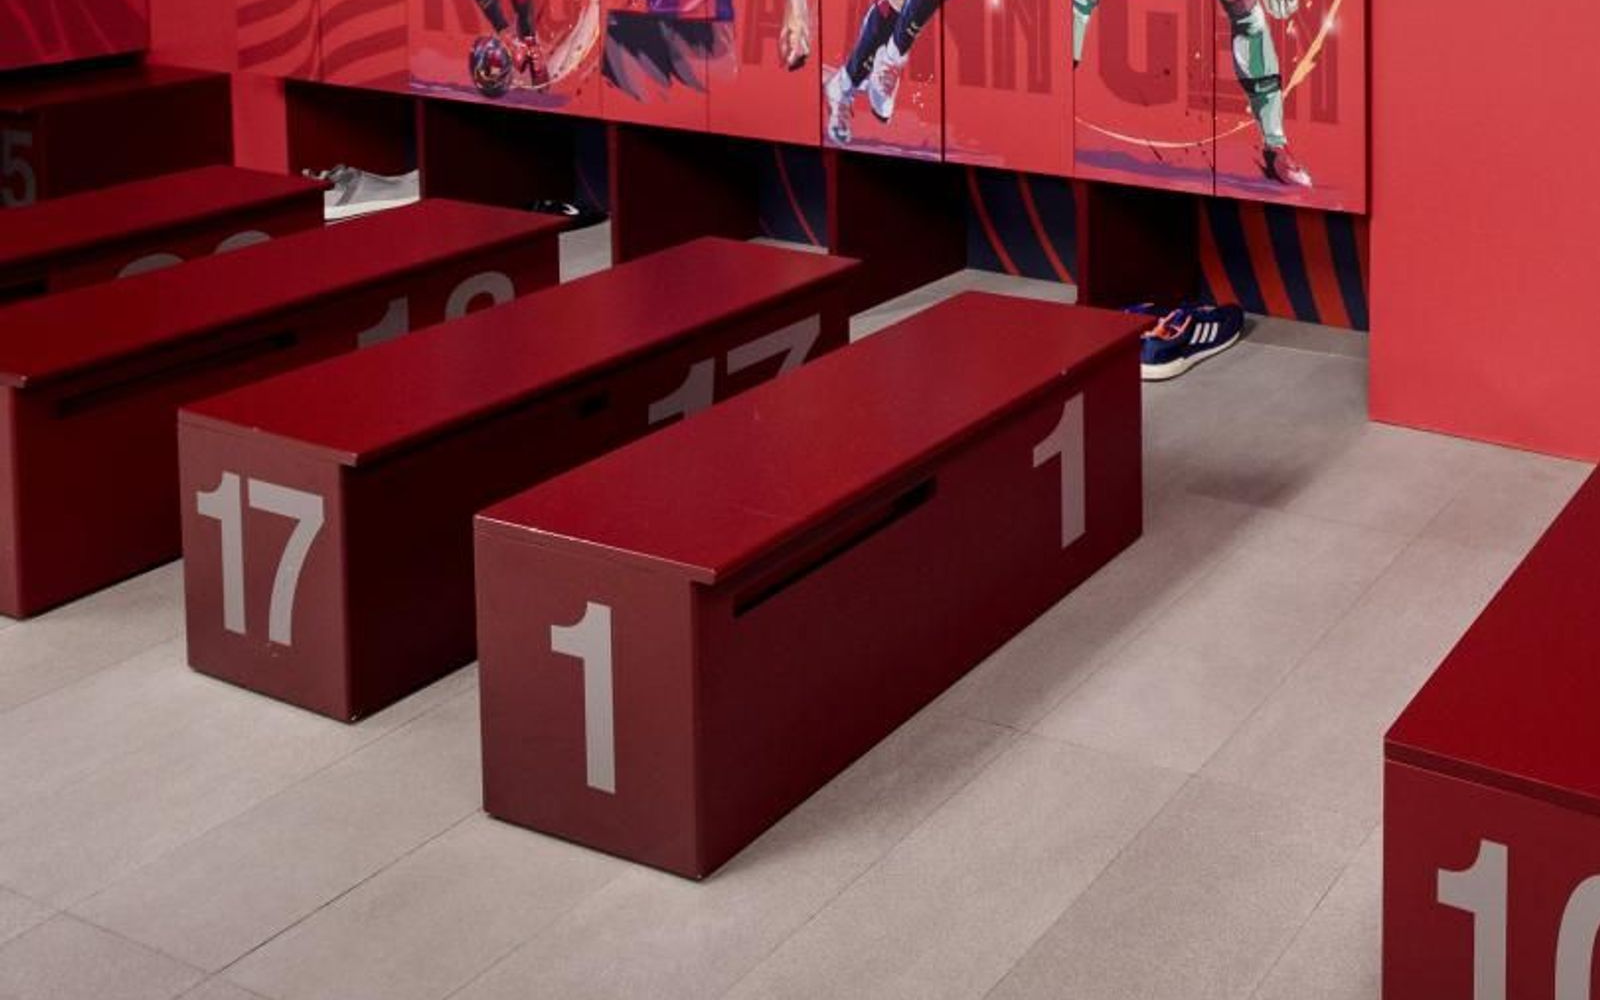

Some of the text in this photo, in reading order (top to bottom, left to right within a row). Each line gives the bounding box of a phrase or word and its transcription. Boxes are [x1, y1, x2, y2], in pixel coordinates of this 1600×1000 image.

[1032, 391, 1086, 549] 1
[196, 471, 325, 647] 17
[549, 600, 617, 795] 1
